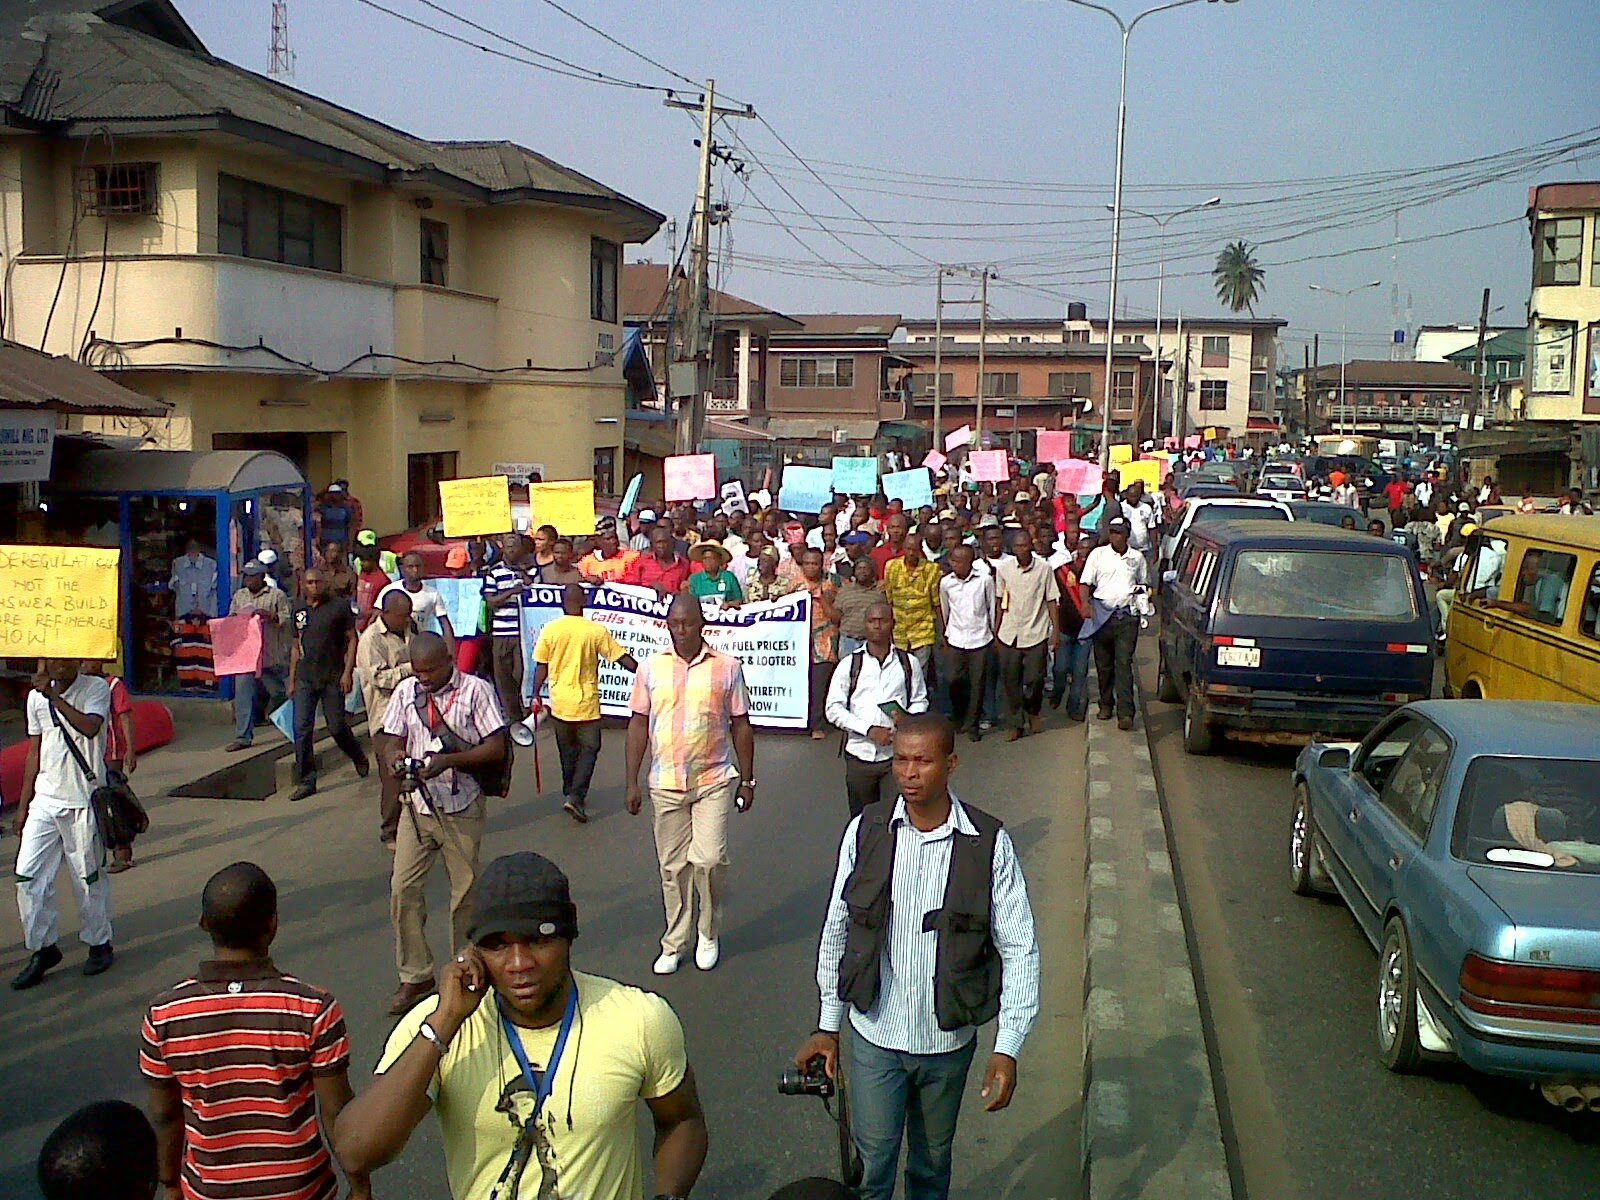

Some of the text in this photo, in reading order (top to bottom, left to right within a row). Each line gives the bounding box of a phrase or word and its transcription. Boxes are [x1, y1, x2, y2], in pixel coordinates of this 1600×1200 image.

[13, 577, 79, 591] NOT THE
[64, 595, 108, 611] BUILD
[593, 588, 669, 616] ACTION
[591, 611, 625, 624] Calls
[610, 629, 626, 641] THE
[732, 640, 755, 651] FUEL
[757, 640, 789, 651] PRICES
[756, 656, 797, 666] LOOTERS
